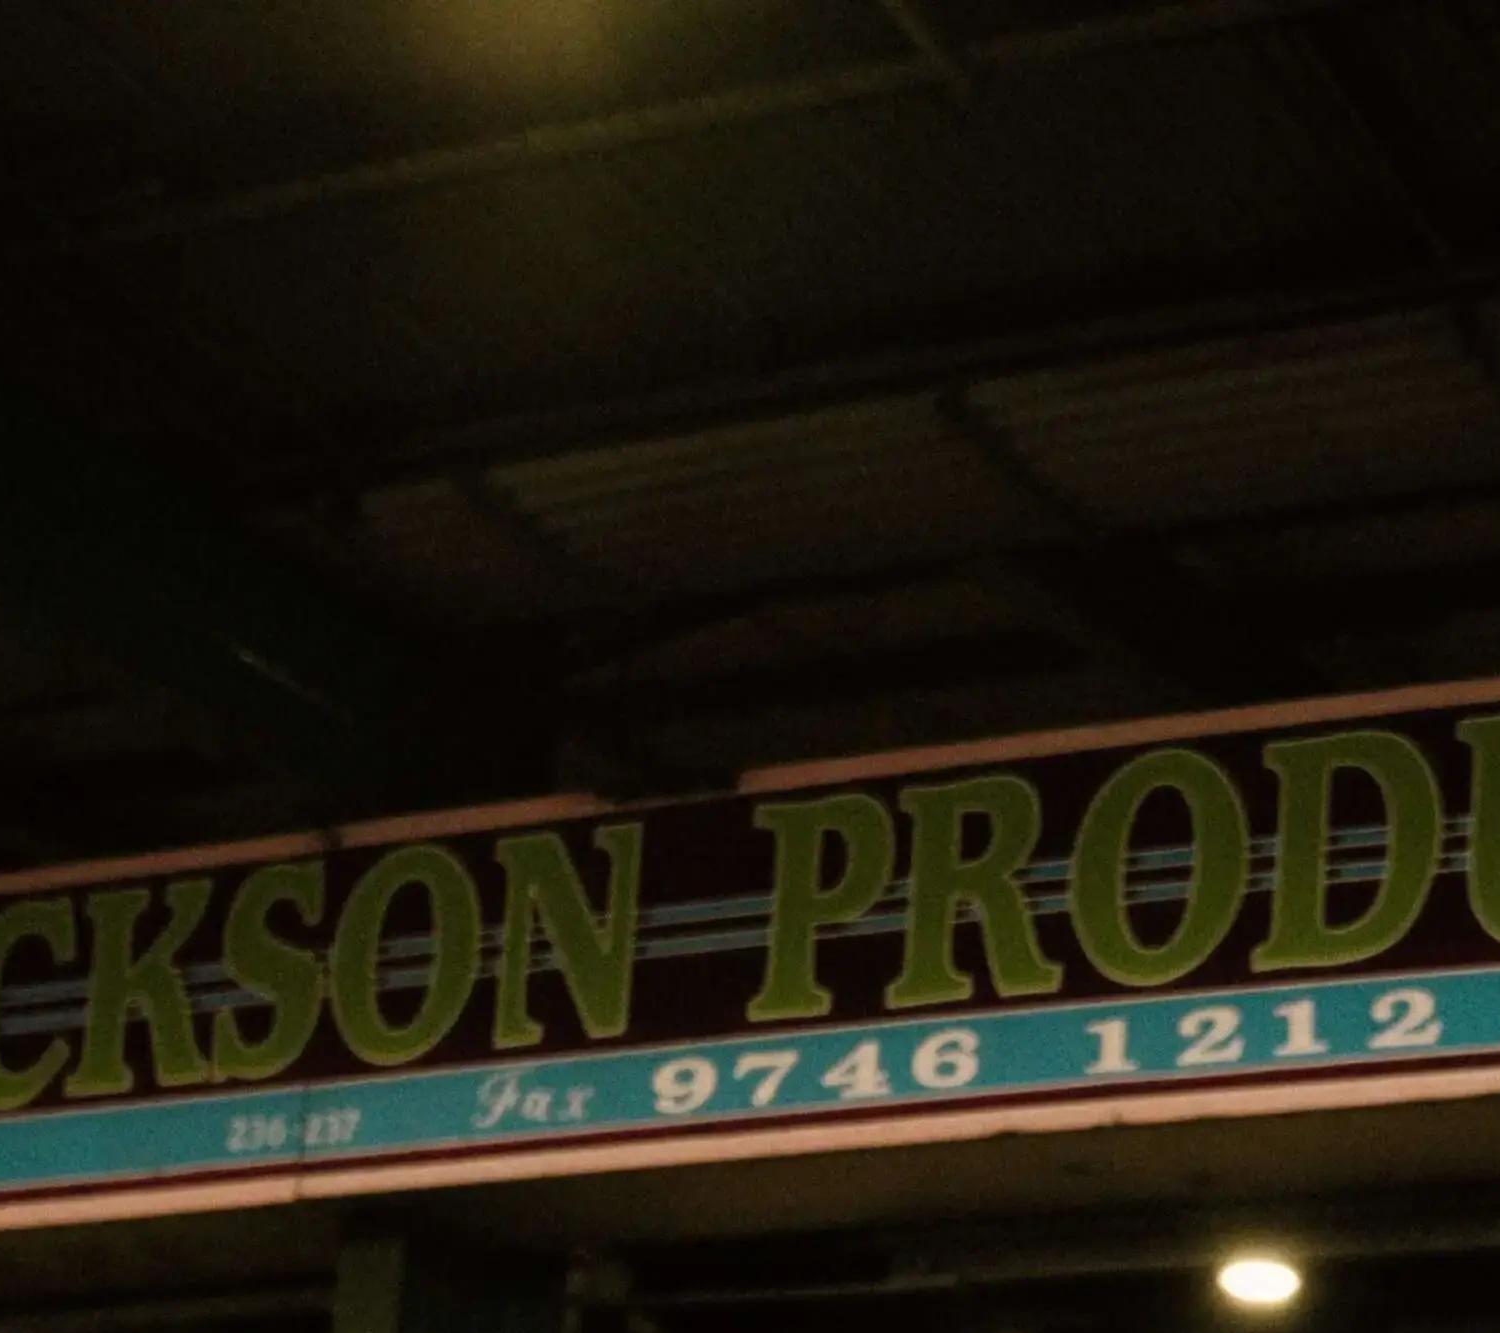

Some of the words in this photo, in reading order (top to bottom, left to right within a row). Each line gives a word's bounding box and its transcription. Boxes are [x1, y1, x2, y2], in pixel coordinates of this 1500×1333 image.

[469, 1071, 595, 1130] Fax
[649, 1028, 982, 1116] 9746
[1086, 988, 1447, 1075] 1212
